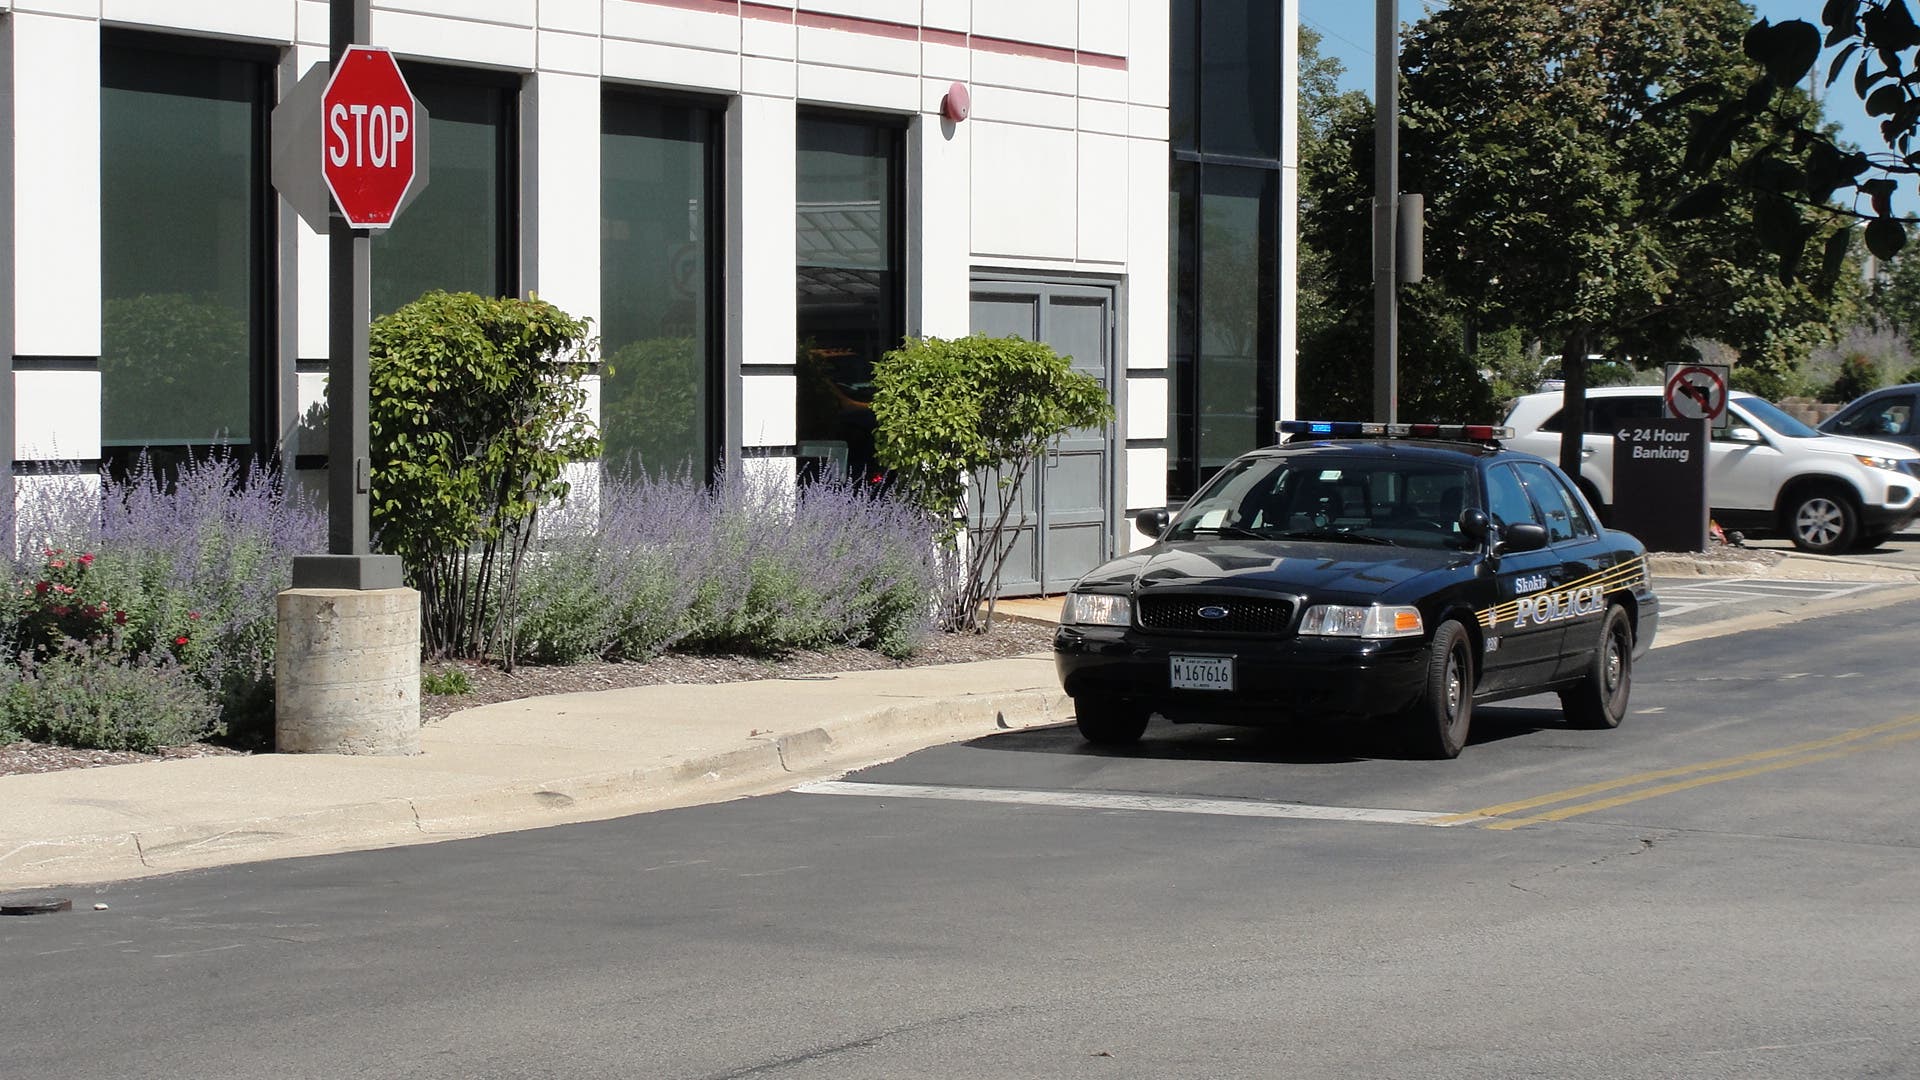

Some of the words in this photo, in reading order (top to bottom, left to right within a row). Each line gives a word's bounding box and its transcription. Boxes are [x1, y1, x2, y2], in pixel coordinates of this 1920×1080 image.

[329, 103, 409, 168] STOP
[1632, 428, 1651, 441] 24
[1653, 428, 1690, 441] Hour
[1632, 445, 1690, 462] Banking
[1515, 575, 1547, 594] Skokie
[1514, 585, 1604, 628] POLICE
[1185, 665, 1228, 682] 167616
